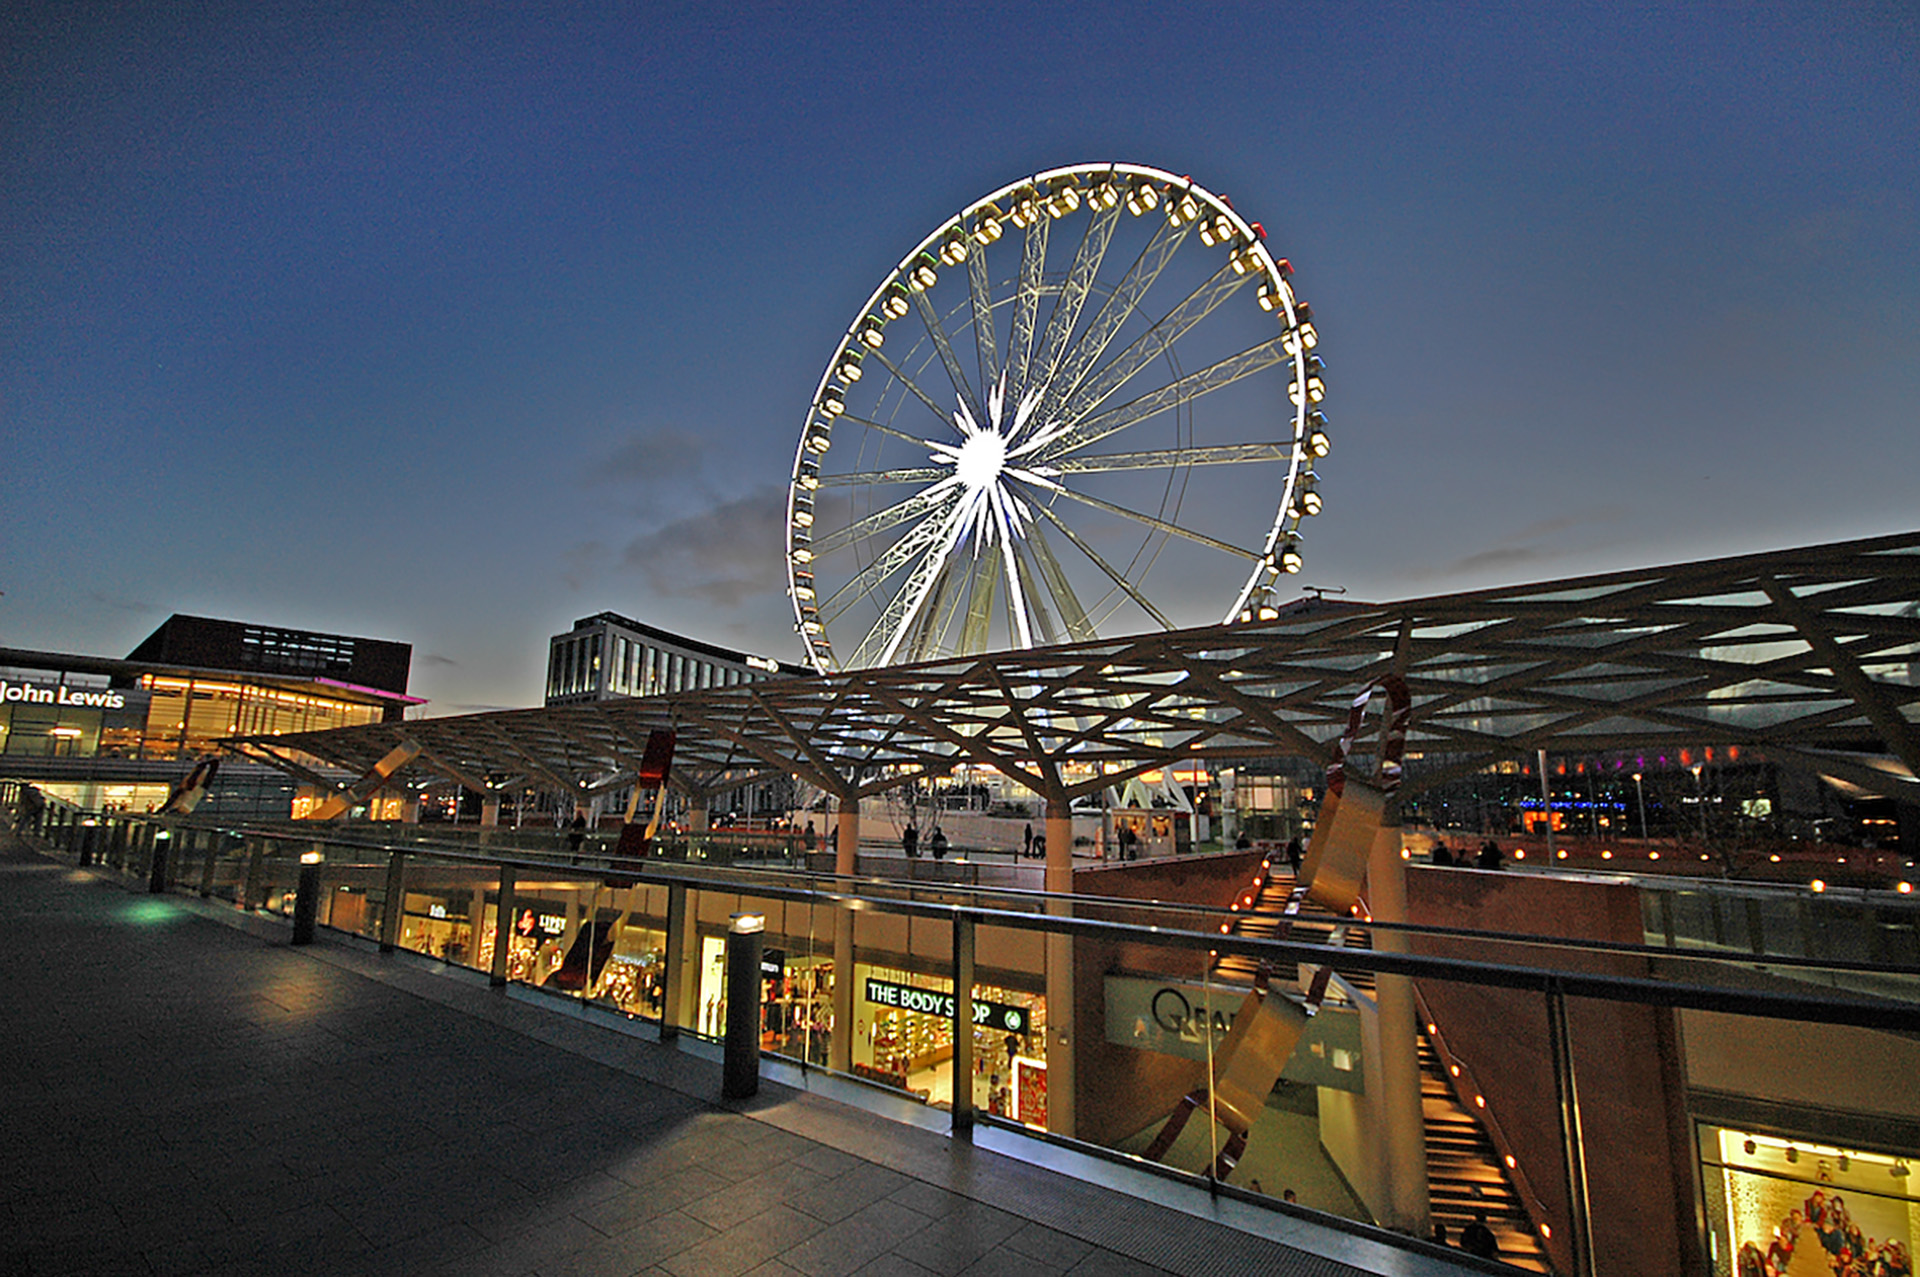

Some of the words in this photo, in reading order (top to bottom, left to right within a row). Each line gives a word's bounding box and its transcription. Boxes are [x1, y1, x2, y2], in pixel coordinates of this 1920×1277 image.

[0, 681, 55, 704] John
[57, 685, 125, 709] Lewis
[868, 982, 898, 1005] THE
[900, 989, 944, 1015] BODY
[945, 998, 991, 1024] SOP
